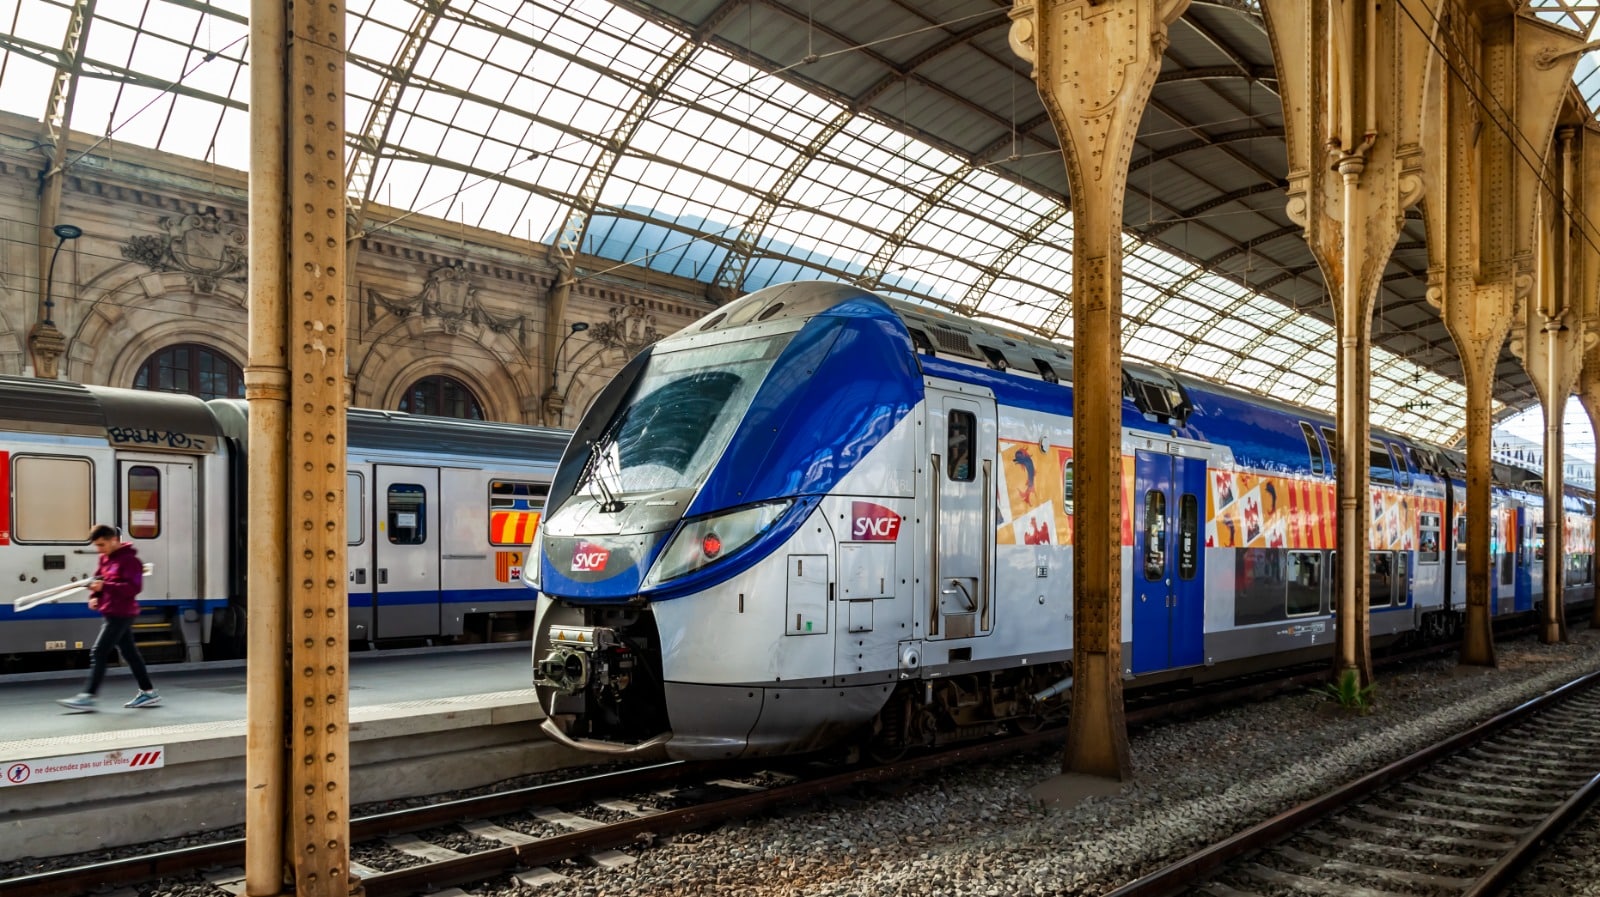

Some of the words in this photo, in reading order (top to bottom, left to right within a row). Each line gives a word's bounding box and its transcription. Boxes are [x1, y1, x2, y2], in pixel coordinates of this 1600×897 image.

[854, 517, 898, 536] SNCF
[573, 553, 607, 567] SNCF
[45, 762, 78, 773] descendez
[80, 761, 91, 770] pas
[103, 758, 113, 767] les
